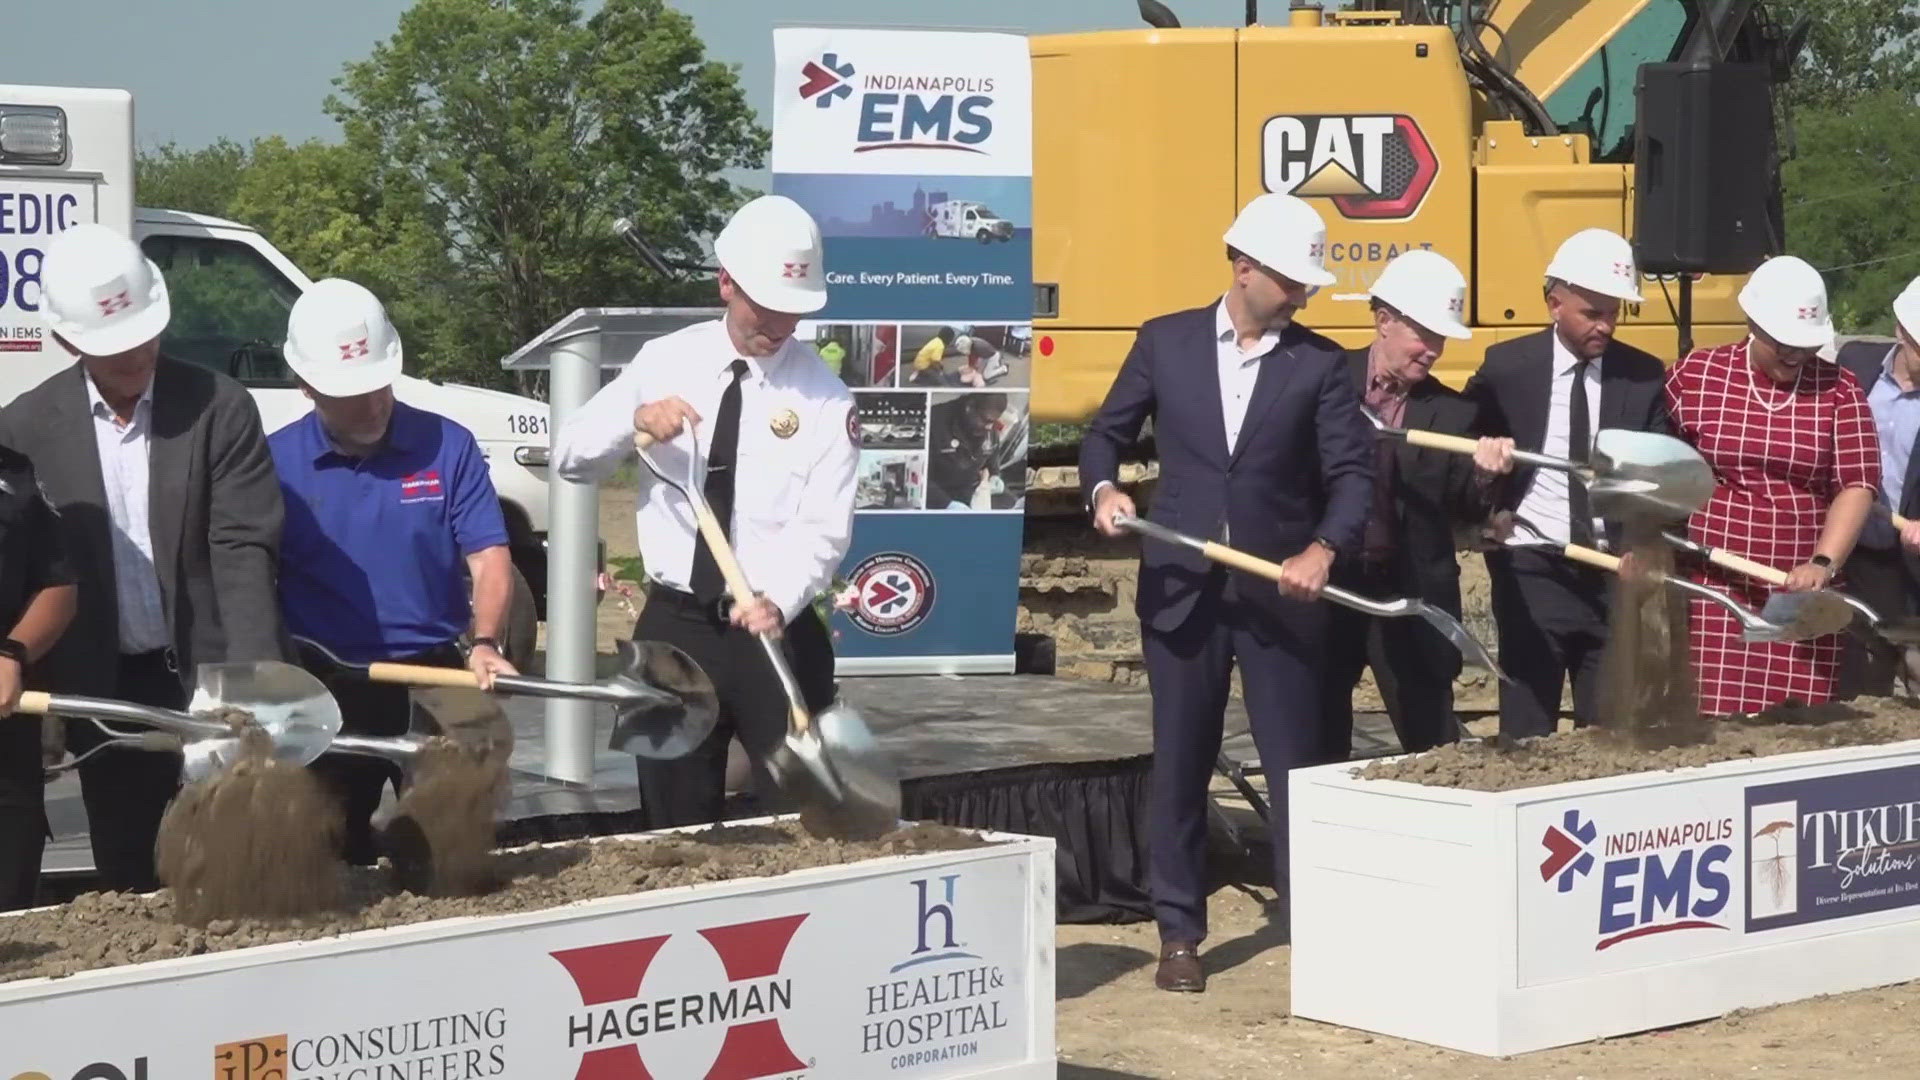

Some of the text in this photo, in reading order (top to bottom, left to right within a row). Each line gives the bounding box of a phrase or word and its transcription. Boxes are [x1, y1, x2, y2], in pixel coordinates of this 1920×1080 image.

[864, 75, 994, 92] INDIANAPOLIS
[857, 93, 994, 144] EMS
[1264, 116, 1394, 195] CAT
[0, 193, 78, 234] EDIC
[825, 272, 1014, 287] Care. Every Patient. Every Time.
[12, 327, 42, 339] IEMS
[508, 414, 547, 434] 1881
[1605, 818, 1733, 856] INDIANAPOLIS
[1837, 840, 1916, 889] Solutions
[1599, 844, 1733, 934] EMS
[569, 979, 792, 1048] HAGERMAN
[861, 1001, 1007, 1053] HOSPITAL
[291, 1007, 507, 1072] CONSULTING
[891, 1041, 978, 1070] CORPORATION
[295, 1044, 505, 1080] INEERS
